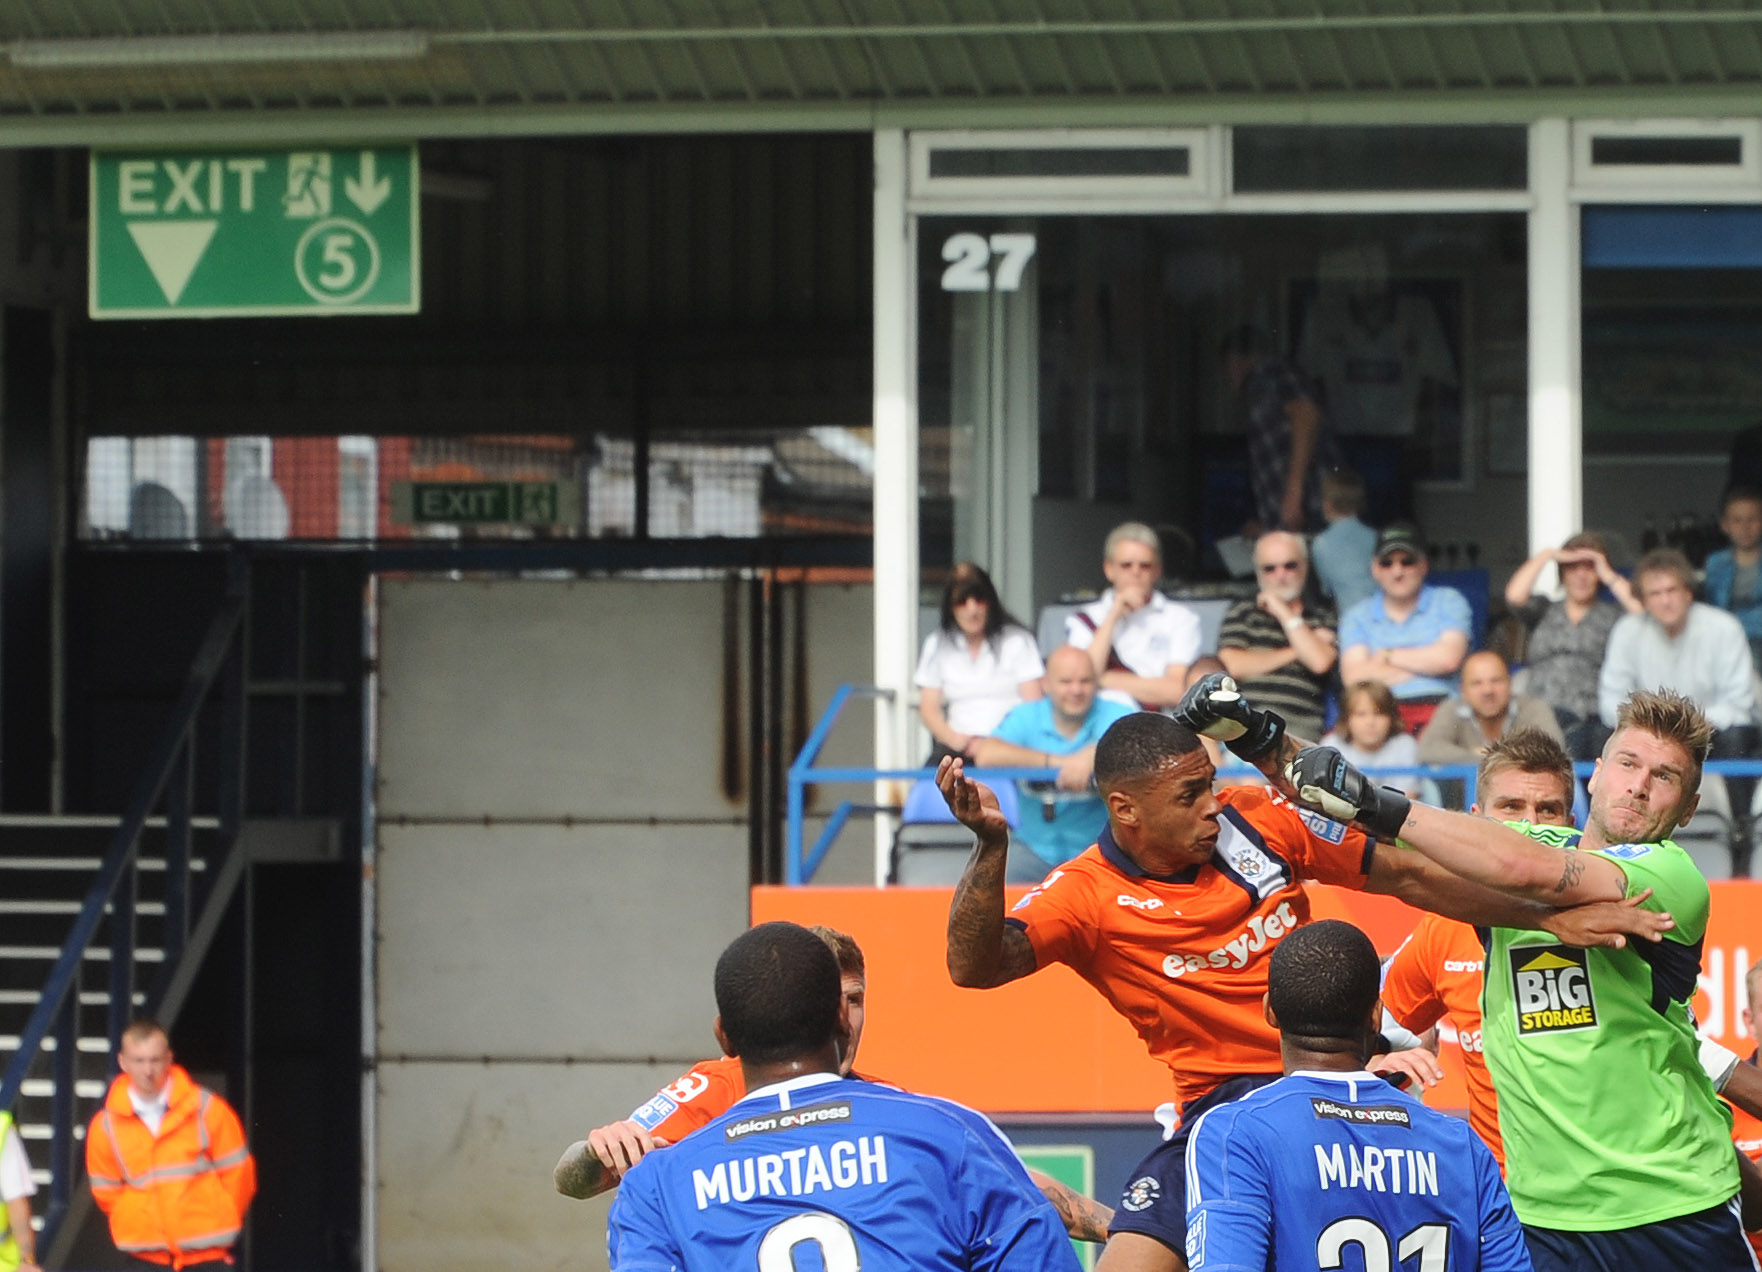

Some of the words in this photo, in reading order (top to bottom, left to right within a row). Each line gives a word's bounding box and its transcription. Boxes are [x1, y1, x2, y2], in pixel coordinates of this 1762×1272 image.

[119, 160, 266, 215] EXIT
[319, 233, 356, 289] 5
[941, 233, 1036, 291] 27
[422, 488, 494, 518] EXIT
[1162, 901, 1297, 978] easyJet
[1516, 966, 1591, 1014] BiG
[1521, 1007, 1594, 1030] STORAGE
[726, 1118, 776, 1138] vision
[780, 1106, 850, 1127] express
[1314, 1101, 1353, 1119] vision
[1354, 1107, 1409, 1122] express
[692, 1135, 888, 1210] MURTAGH
[1313, 1143, 1439, 1196] MARTIN
